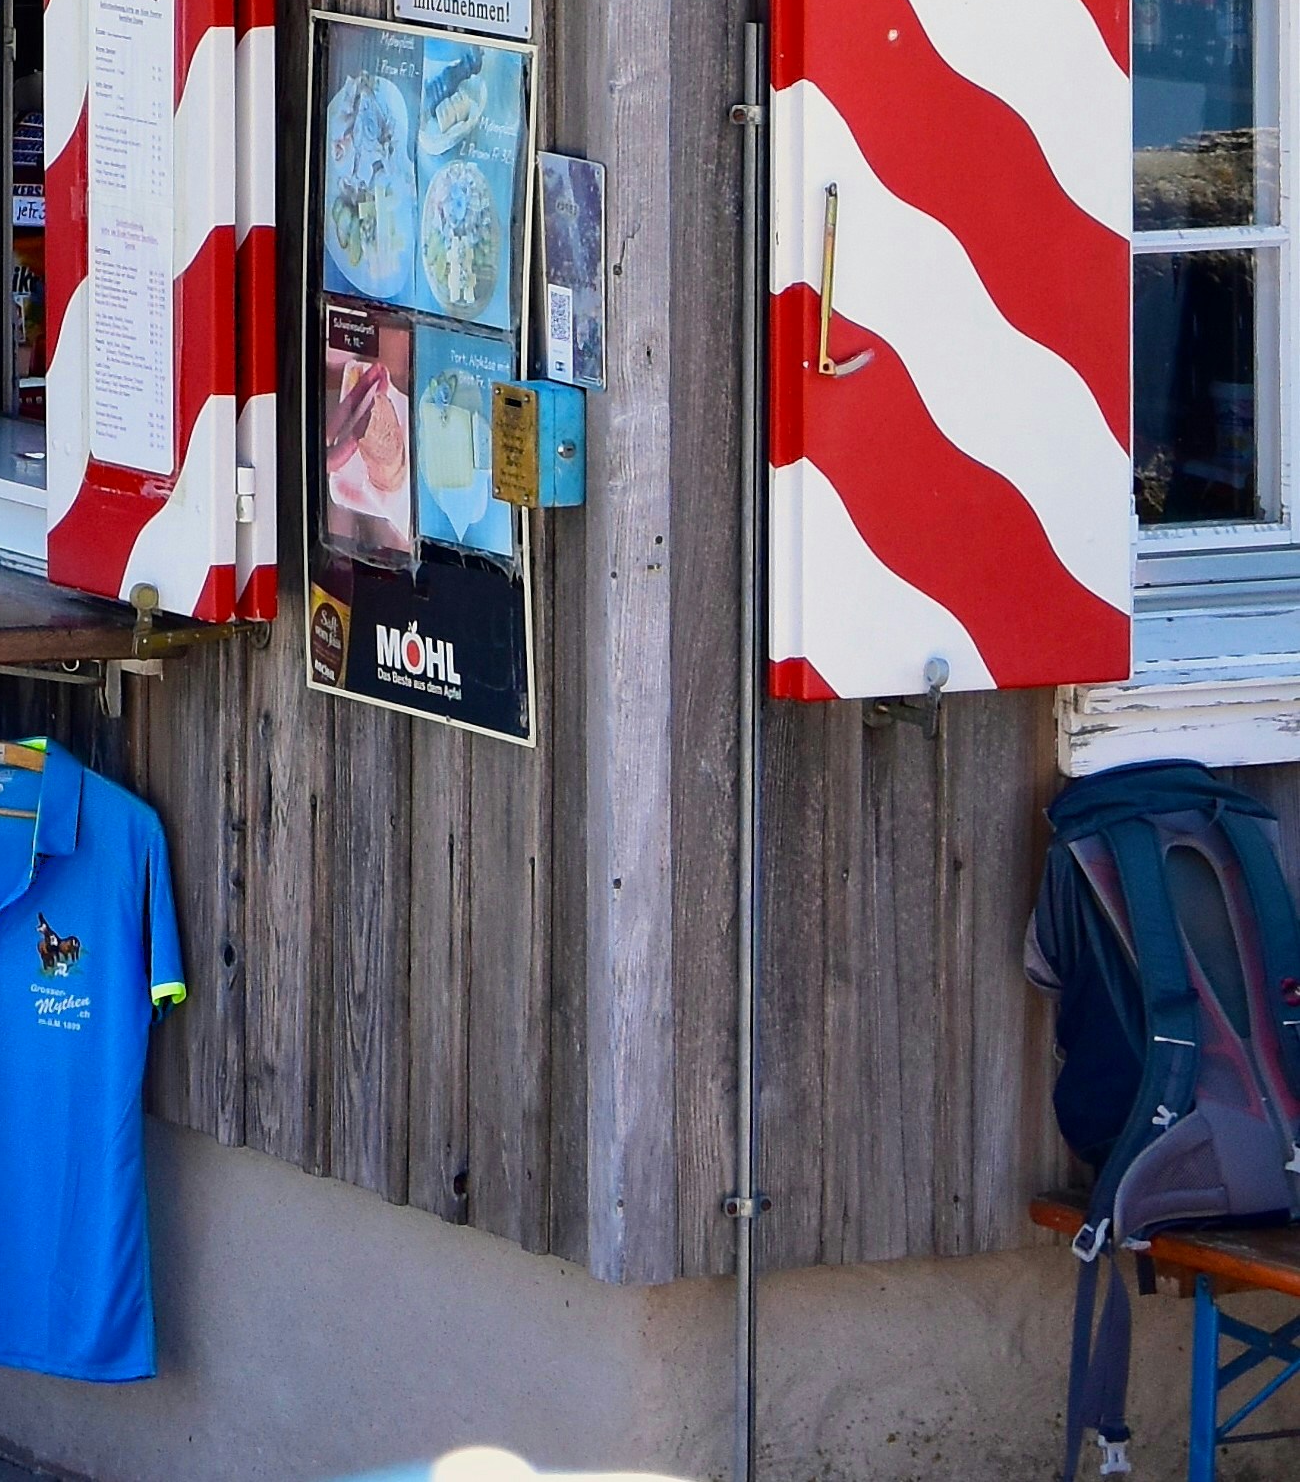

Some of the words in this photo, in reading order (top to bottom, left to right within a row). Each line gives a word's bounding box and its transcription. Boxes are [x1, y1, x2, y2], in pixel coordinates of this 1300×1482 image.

[377, 667, 391, 682] Das
[392, 671, 412, 688] Beste
[413, 677, 426, 691] aus
[426, 680, 443, 695] dem
[443, 684, 462, 701] Apfel
[35, 995, 91, 1016] Mythen
